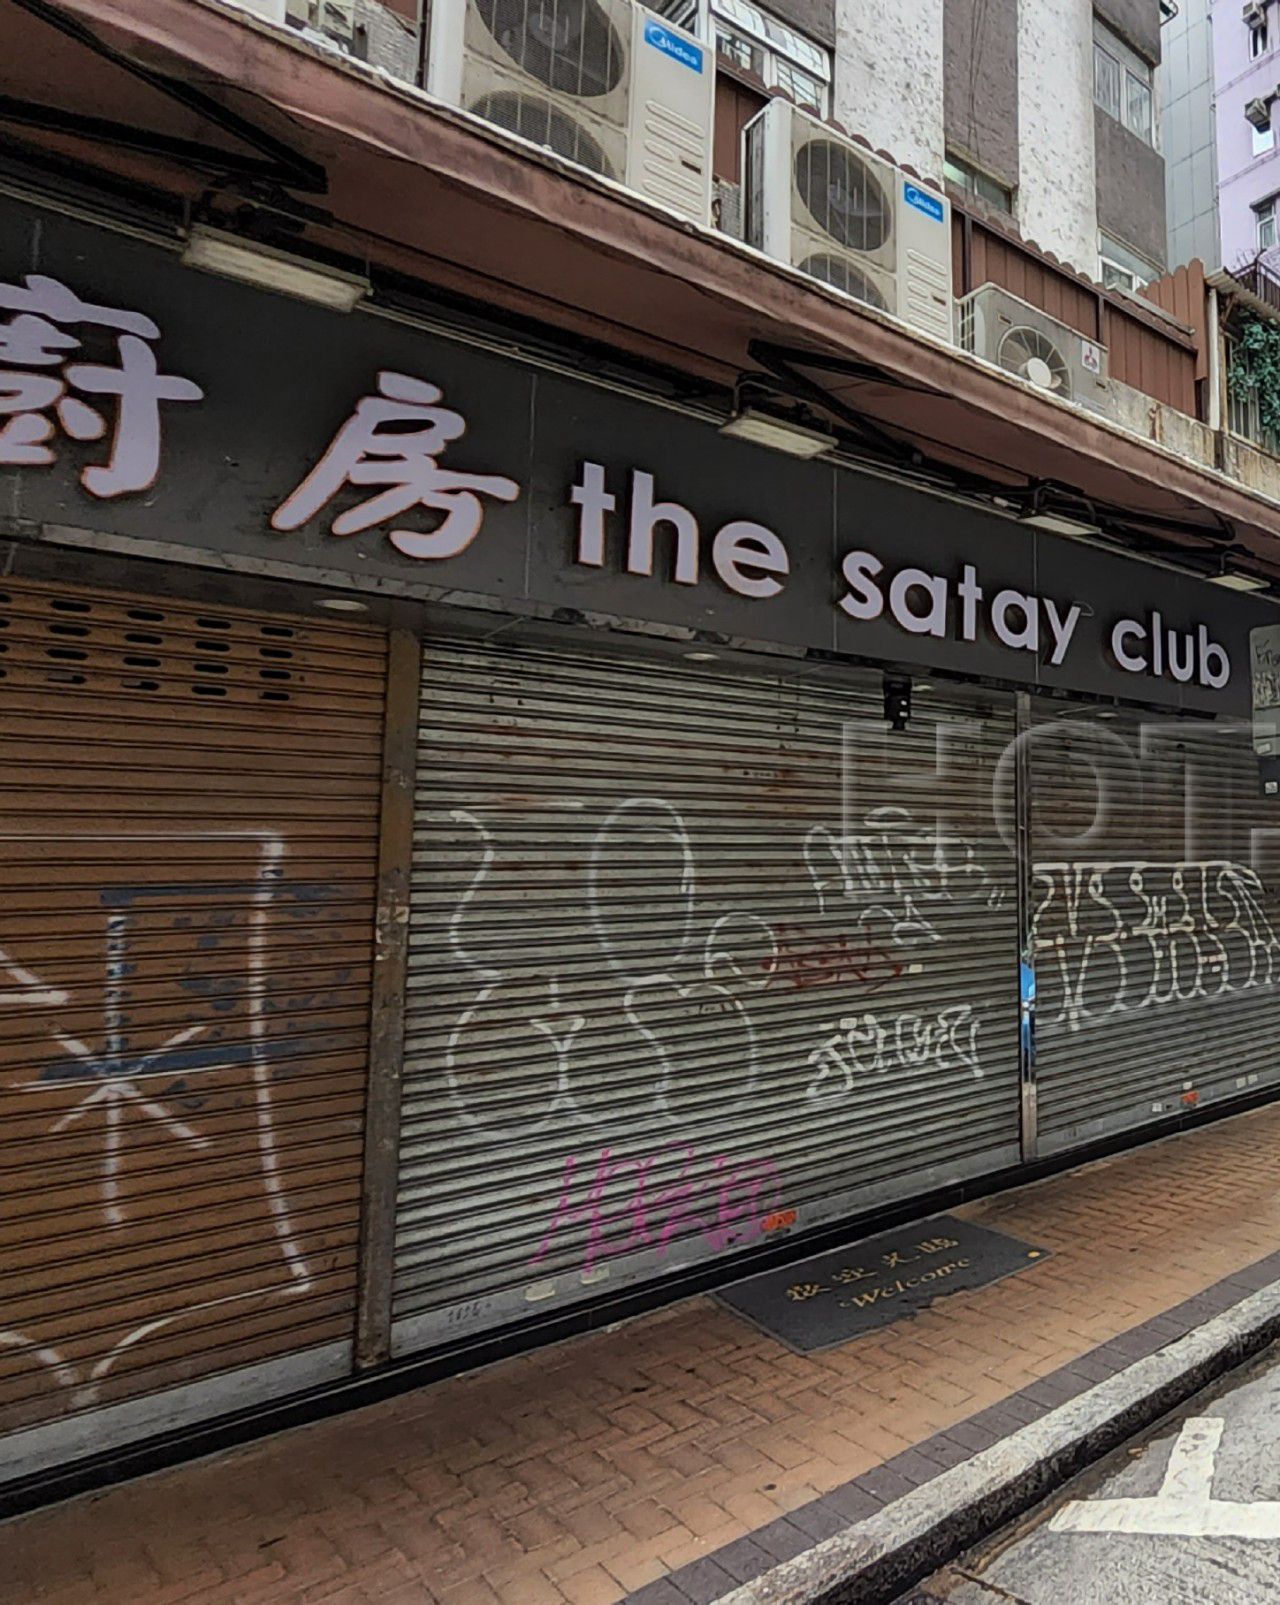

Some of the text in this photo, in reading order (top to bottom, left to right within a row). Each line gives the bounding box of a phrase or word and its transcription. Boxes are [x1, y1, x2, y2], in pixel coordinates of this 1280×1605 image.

[649, 26, 698, 66] Midea
[571, 461, 790, 599] the
[838, 549, 1081, 665] satay
[1112, 612, 1231, 689] club
[840, 1257, 970, 1308] Welcome
